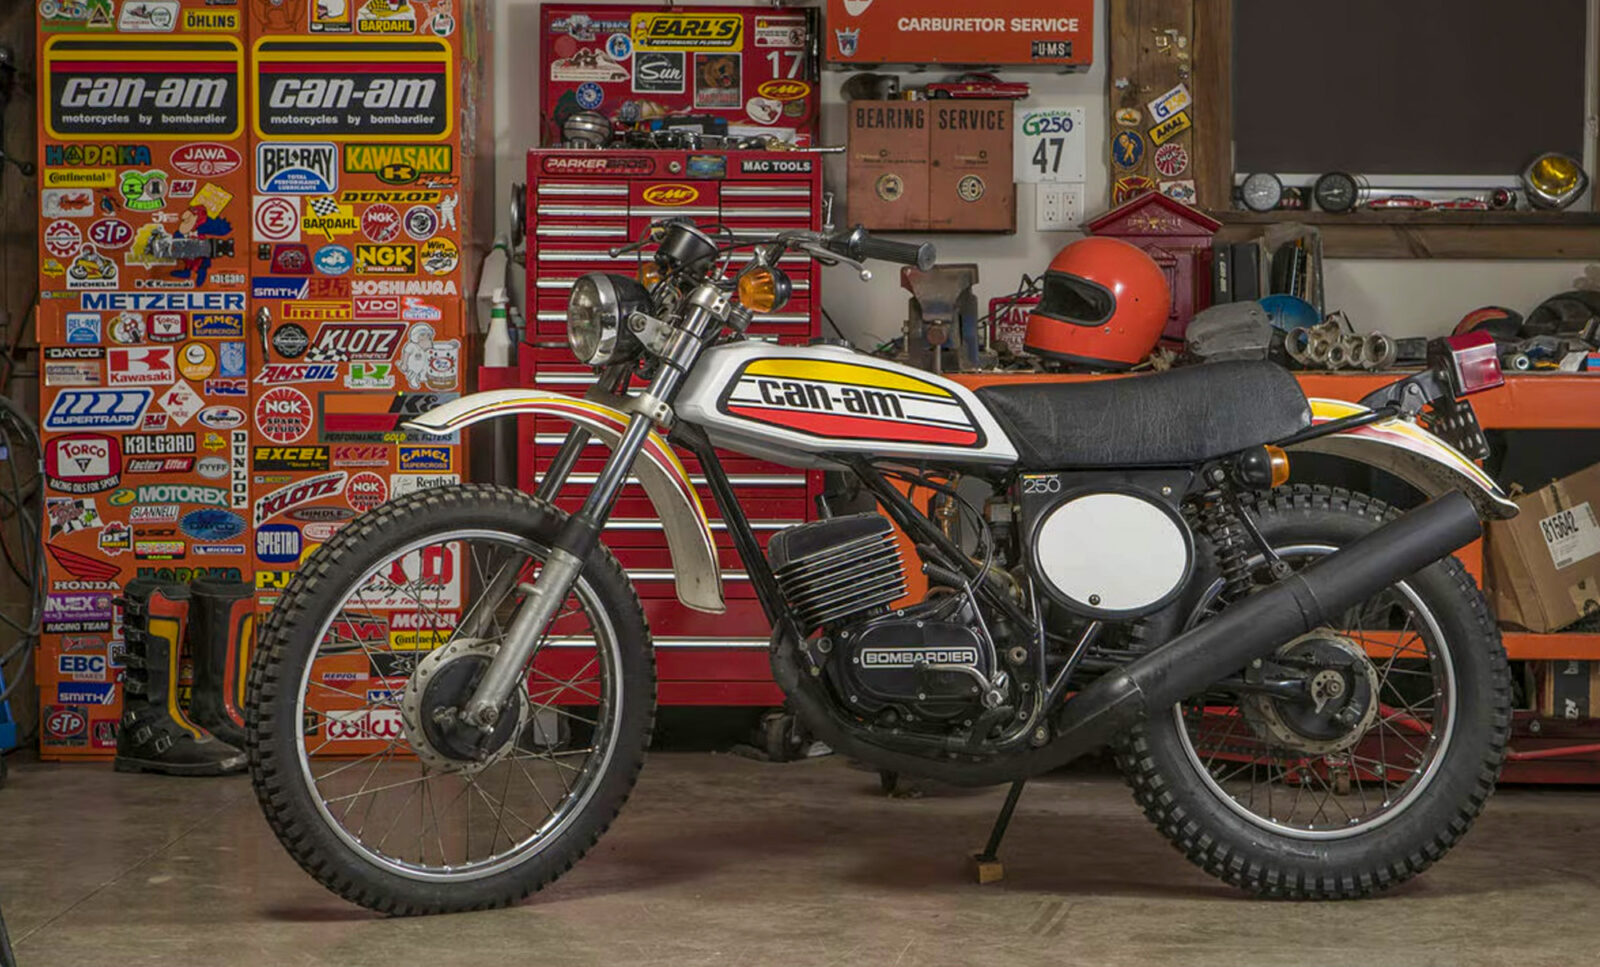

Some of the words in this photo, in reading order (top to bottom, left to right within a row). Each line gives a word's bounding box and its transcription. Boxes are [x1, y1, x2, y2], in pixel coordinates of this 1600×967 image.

[187, 12, 236, 28] ÖHLINS
[361, 20, 413, 33] BARDAHL
[897, 17, 1006, 32] CARBURETOR
[1010, 17, 1079, 32] SERVICE
[651, 20, 733, 37] EARL'S
[641, 62, 683, 80] Sun
[765, 50, 802, 79] 17
[60, 78, 229, 108] can-am
[269, 79, 437, 109] can-am
[764, 85, 804, 95] FMF
[62, 114, 130, 125] motorcycles
[139, 114, 153, 126] by
[162, 114, 227, 124] bombardier
[270, 115, 338, 126] motorcycles
[348, 115, 361, 126] by
[370, 115, 435, 124] bombardier
[856, 108, 925, 130] BEARING
[938, 109, 1006, 131] SERVICE
[1156, 117, 1185, 139] AMAL
[46, 145, 152, 165] HODAKA
[184, 148, 228, 160] JAWA
[347, 147, 451, 171] KAWASAKI
[1032, 137, 1065, 174] 47
[547, 159, 607, 168] PARKER
[742, 161, 770, 171] MAC
[773, 161, 811, 171] TOOLS
[49, 173, 106, 183] Continental
[342, 192, 439, 202] DUNLOP
[650, 190, 694, 200] FMF
[303, 218, 358, 229] BARDAHL
[368, 213, 395, 222] NGK
[94, 221, 128, 242] STP
[427, 241, 446, 250] Win
[359, 246, 413, 266] NGK
[254, 287, 298, 297] SMITH
[352, 280, 457, 296] YOSHIMURA
[82, 294, 245, 310] METZELER
[356, 300, 397, 311] VDO
[284, 303, 350, 318] PIRELLI
[194, 315, 241, 328] CAMEL
[319, 329, 399, 353] KLOTZ
[51, 349, 100, 358] DAYCO
[110, 372, 172, 383] Kawasaki
[258, 365, 339, 381] AMSOIL
[205, 381, 247, 395] HRC
[758, 378, 906, 419] can-am
[266, 401, 302, 413] NGK
[52, 415, 135, 425] SUPERTRAPP
[324, 433, 383, 441] PERFORMANCE
[384, 433, 406, 441] GOLD
[407, 433, 420, 441] OIL
[422, 433, 453, 441] FILTERS
[59, 443, 106, 459] TORCO
[255, 447, 329, 460] EXCEL
[335, 447, 389, 459] KYB
[401, 450, 449, 463] CAMEL
[128, 460, 164, 471] Factory
[165, 459, 188, 470] Effex
[233, 432, 246, 506] DUNLOP
[50, 479, 72, 491] RACING
[87, 481, 99, 492] FOR
[99, 475, 120, 490] SPORT
[353, 482, 379, 492] NGK
[416, 476, 457, 488] Renthal
[1023, 478, 1061, 493] 250
[139, 486, 229, 505] MOTOREX
[262, 476, 347, 520] KLOTZ
[300, 510, 343, 518] HINDLE
[1542, 511, 1580, 544] 815642
[257, 531, 299, 555] SPECTRO
[54, 581, 120, 590] HONDA
[386, 599, 396, 607] by
[47, 623, 81, 632] RACING
[82, 622, 109, 631] TEAM
[392, 614, 457, 629] MOTUL
[59, 656, 105, 672] EBC
[866, 651, 974, 664] BOMBARDIER
[59, 693, 103, 702] SMITH
[51, 715, 81, 731] STP
